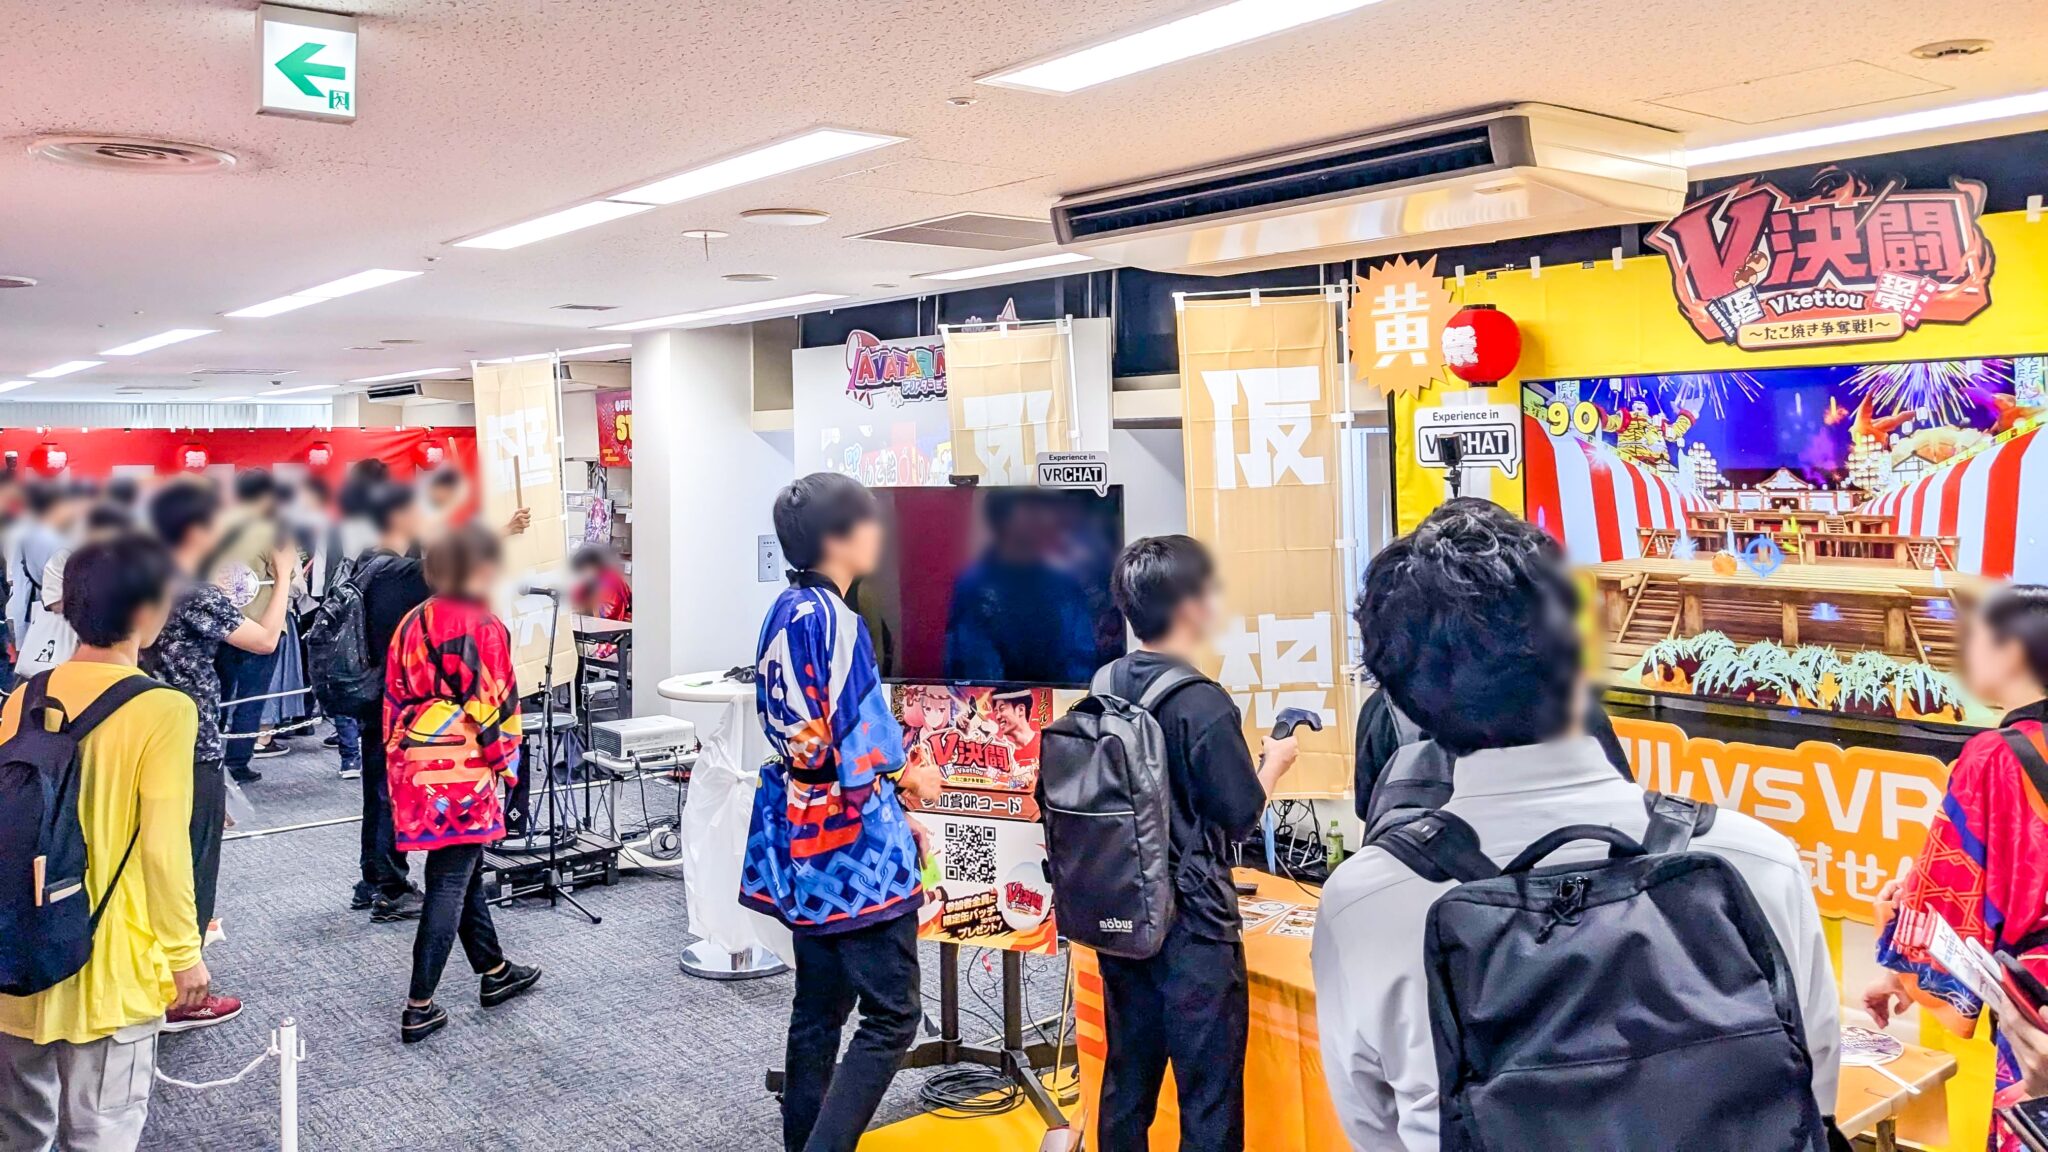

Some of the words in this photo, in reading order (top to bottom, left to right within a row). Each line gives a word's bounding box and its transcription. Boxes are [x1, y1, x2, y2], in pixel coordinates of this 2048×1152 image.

[1668, 190, 1962, 302] V決闘
[1768, 290, 1866, 316] Vkettou
[1371, 282, 1431, 369] 黄
[1708, 303, 1737, 338] VIRTUAL
[859, 349, 935, 380] AVATAR
[1432, 411, 1488, 422] Experience
[1489, 409, 1499, 419] in
[1548, 401, 1599, 436] 90
[1425, 430, 1508, 455] VCHAT
[1043, 467, 1101, 482] VRCHAT
[1099, 917, 1133, 929] möbus
